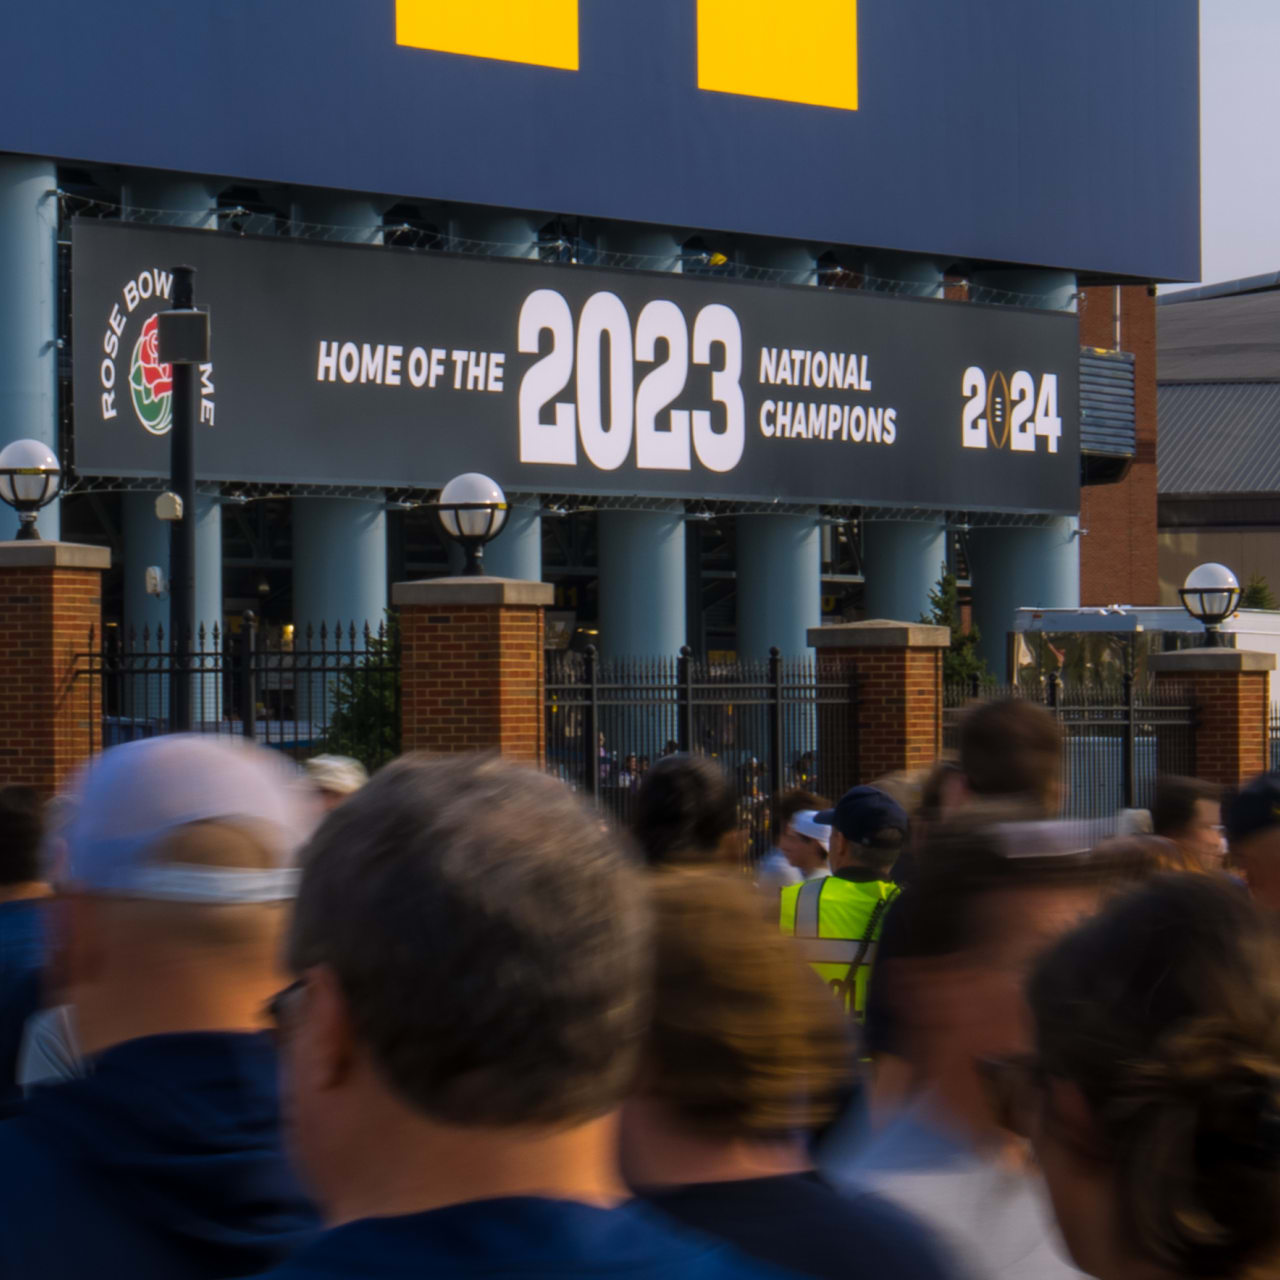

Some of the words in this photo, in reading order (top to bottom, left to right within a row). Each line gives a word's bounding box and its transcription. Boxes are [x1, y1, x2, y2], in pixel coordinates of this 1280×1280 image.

[101, 302, 127, 420] ROSE
[123, 268, 173, 312] BOW
[317, 340, 403, 386] HOME
[408, 346, 447, 388] OF
[451, 349, 506, 392] THE
[517, 288, 746, 473] 2023
[759, 346, 872, 391] NATIONAL
[759, 399, 897, 445] CHAMPIONS
